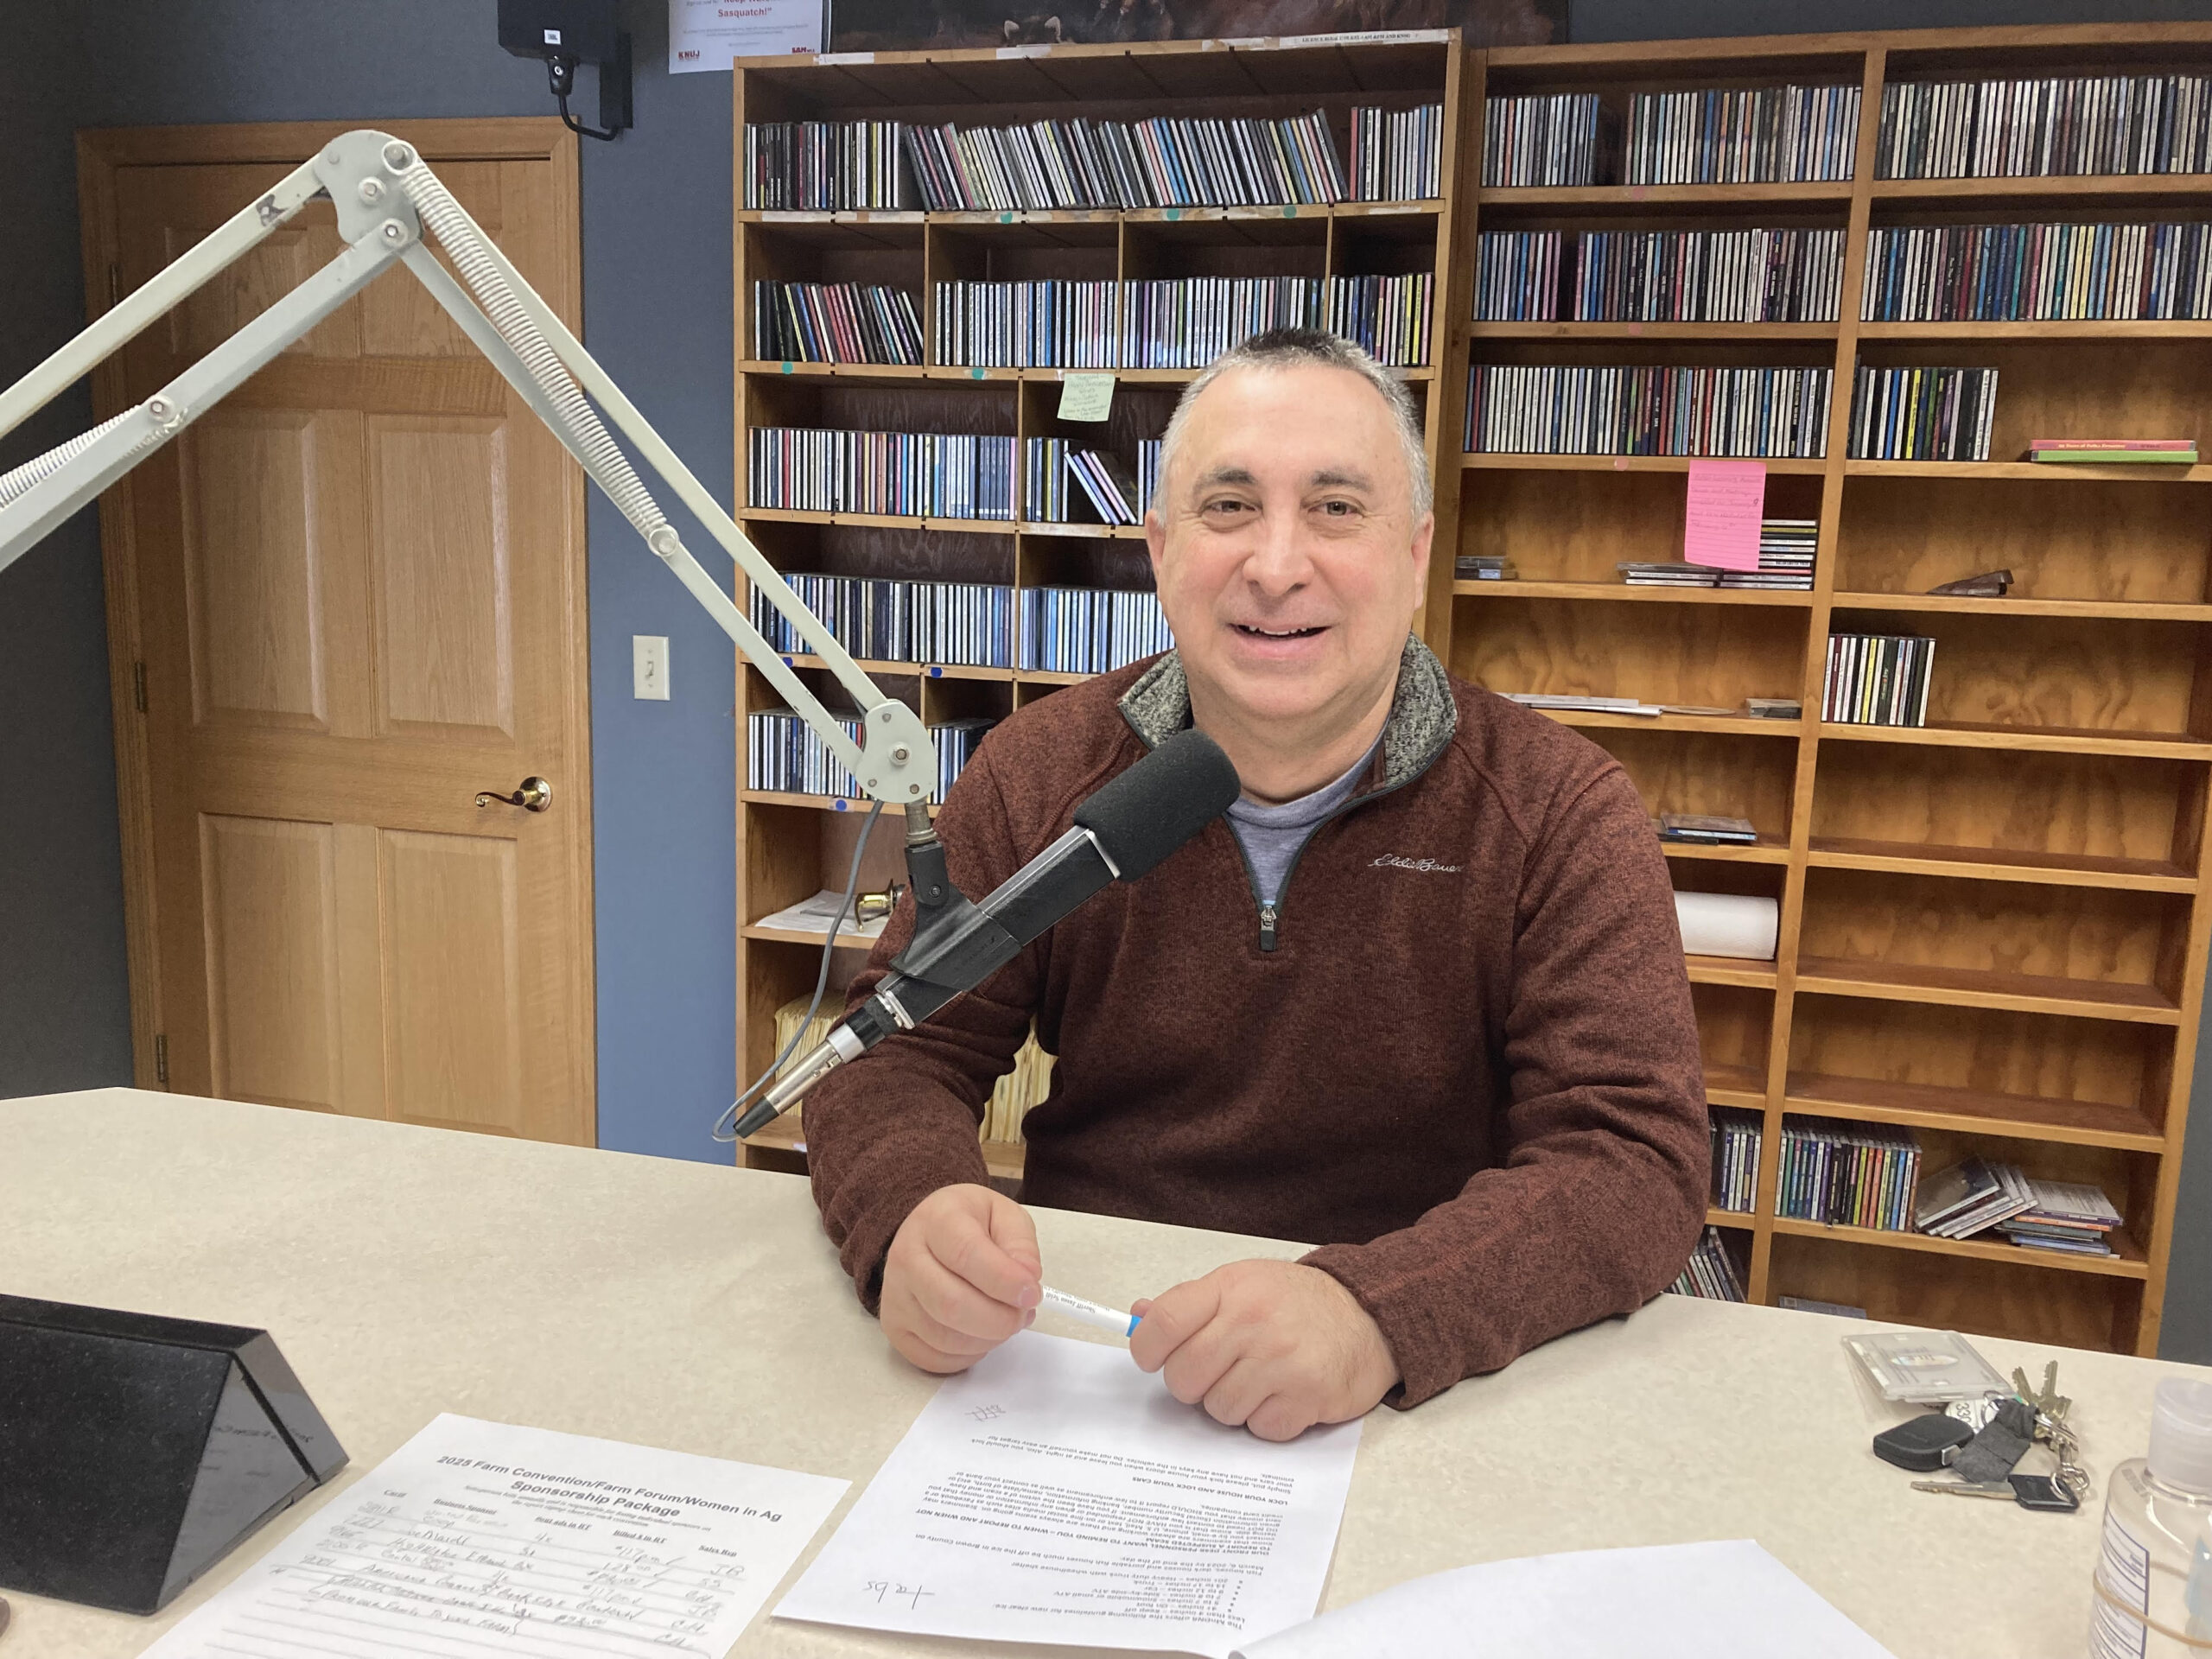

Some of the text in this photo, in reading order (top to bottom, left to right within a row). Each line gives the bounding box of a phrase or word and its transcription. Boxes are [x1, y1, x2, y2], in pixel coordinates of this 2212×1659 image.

[678, 50, 700, 60] KNUJ
[1368, 854, 1415, 868] Eddie
[436, 1456, 471, 1467] 2025
[473, 1460, 509, 1474] Farm
[512, 1468, 632, 1495] Convention/Farm
[634, 1488, 740, 1515] Forum/Women
[760, 1510, 783, 1522] Ag
[1216, 1489, 1243, 1498] HOUSE
[511, 1480, 610, 1504] Sponsorship
[613, 1497, 681, 1516] Package
